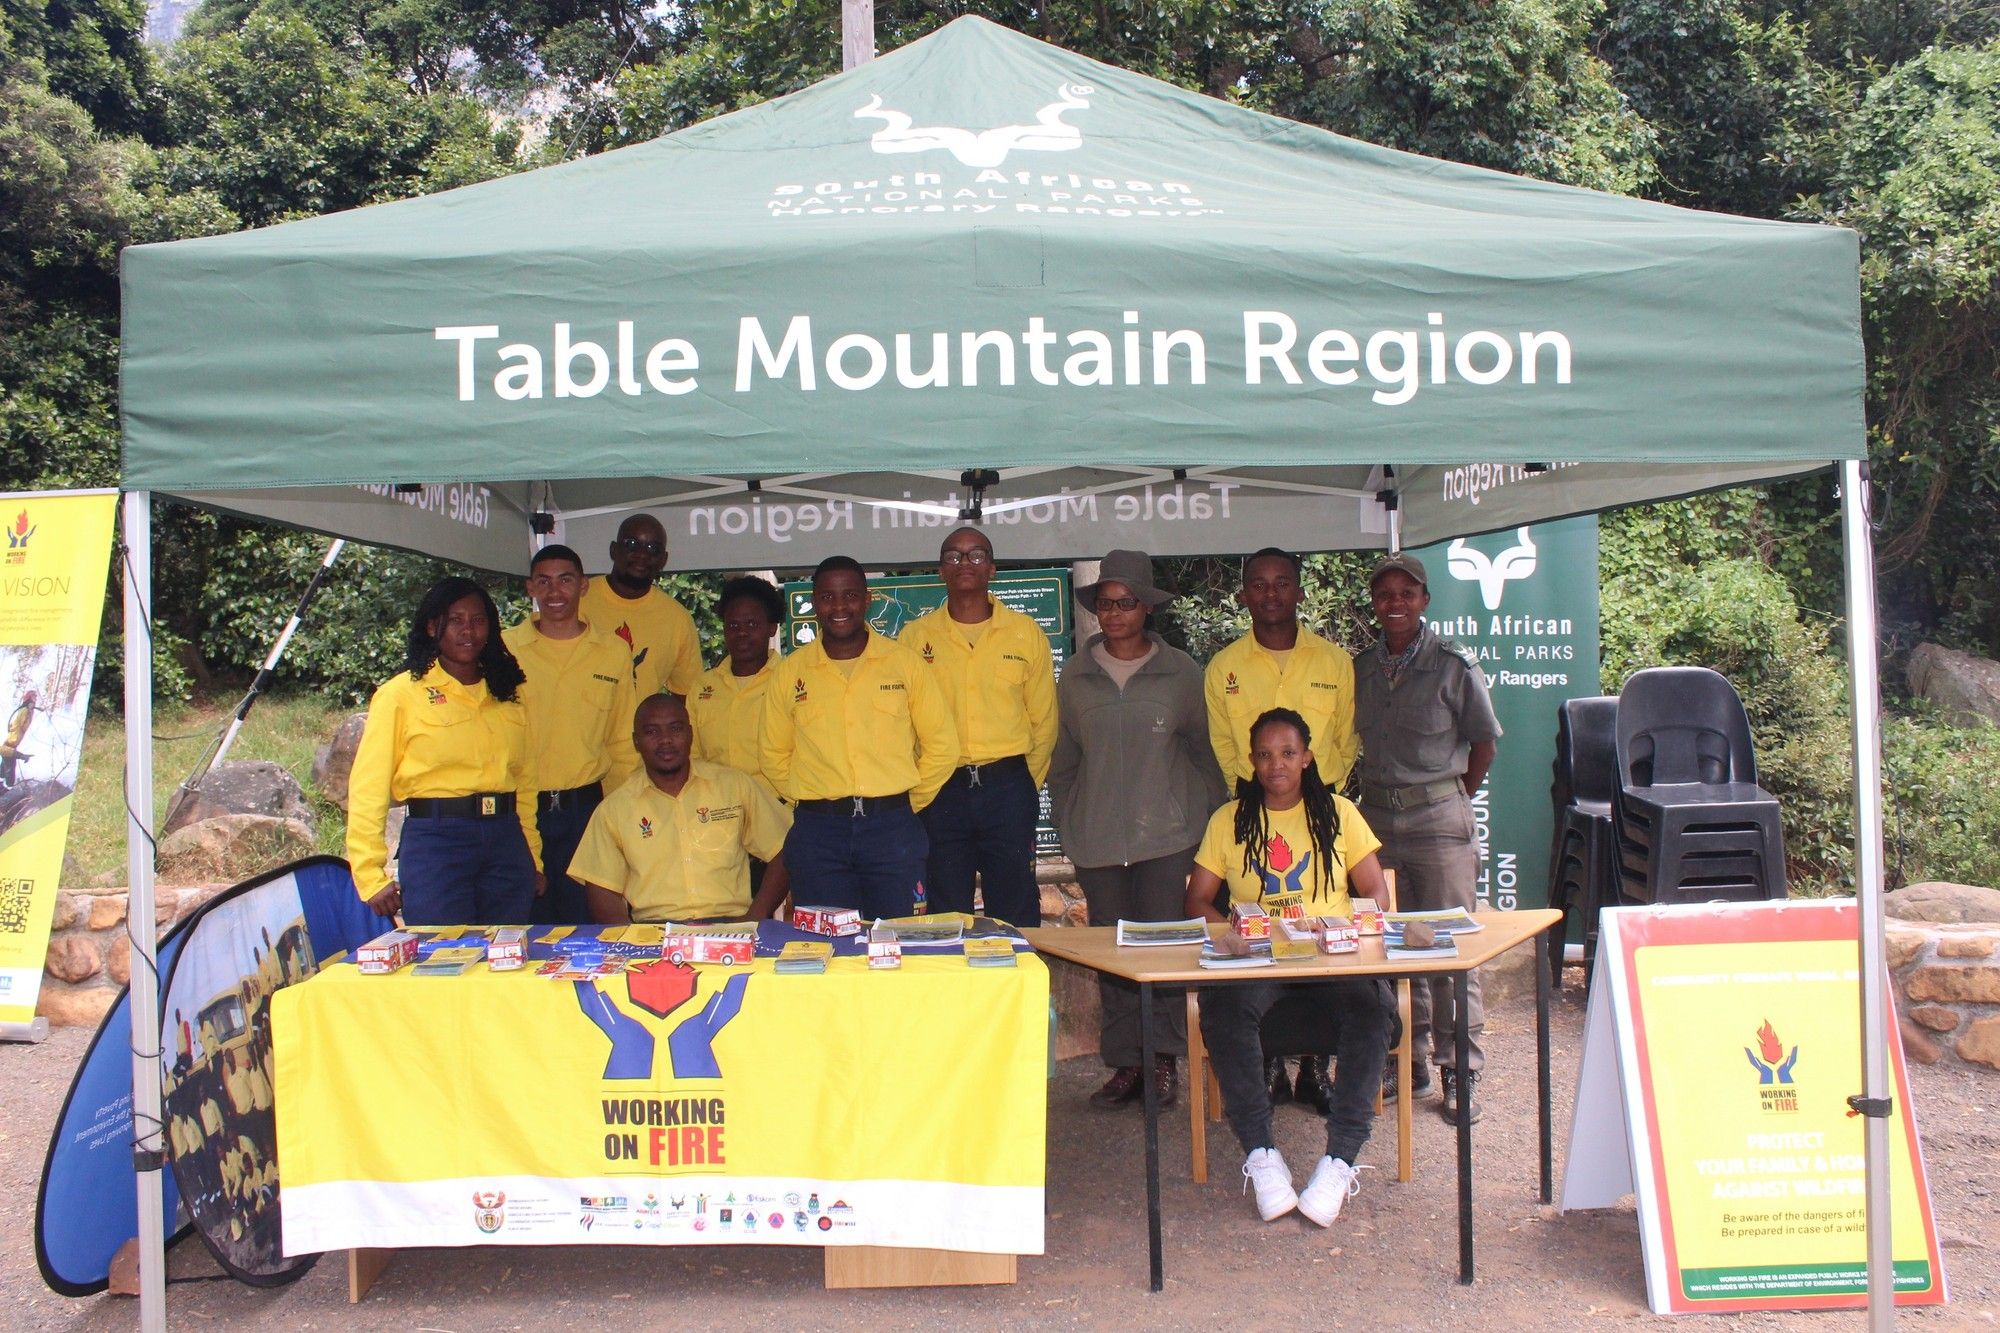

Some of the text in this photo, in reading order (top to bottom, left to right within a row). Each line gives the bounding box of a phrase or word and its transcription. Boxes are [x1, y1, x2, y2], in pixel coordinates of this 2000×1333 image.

[774, 169, 1192, 196] South African
[768, 188, 1203, 209] NATIONAL PARKS
[772, 203, 997, 217] Honorary
[434, 309, 1573, 406] Table Mountain Region
[4, 576, 71, 597] VISION
[1489, 614, 1573, 636] African
[1515, 645, 1574, 660] PARKS
[1500, 670, 1568, 689] Rangers
[1498, 853, 1517, 911] GION
[1269, 907, 1281, 917] ON
[1760, 1089, 1797, 1099] WORKING
[601, 1098, 725, 1126] WORKING
[1762, 1099, 1799, 1112] ON FIRE
[604, 1126, 726, 1166] ON FIRE
[1747, 1132, 1825, 1149] PROTECT
[1696, 1157, 1745, 1175] YOUR
[1723, 1213, 1737, 1223] Be
[1739, 1214, 1769, 1223] aware
[1772, 1212, 1783, 1221] of
[1785, 1211, 1801, 1221] the
[1803, 1210, 1843, 1222] dangers
[1846, 1209, 1859, 1219] of
[1721, 1227, 1735, 1237] Be
[1738, 1226, 1783, 1238] prepared
[1785, 1225, 1795, 1234] in
[1798, 1225, 1821, 1234] case
[1823, 1224, 1834, 1233] of
[1836, 1225, 1842, 1233] a
[1690, 1284, 1711, 1292] WHICH
[1712, 1283, 1737, 1291] RESIDES
